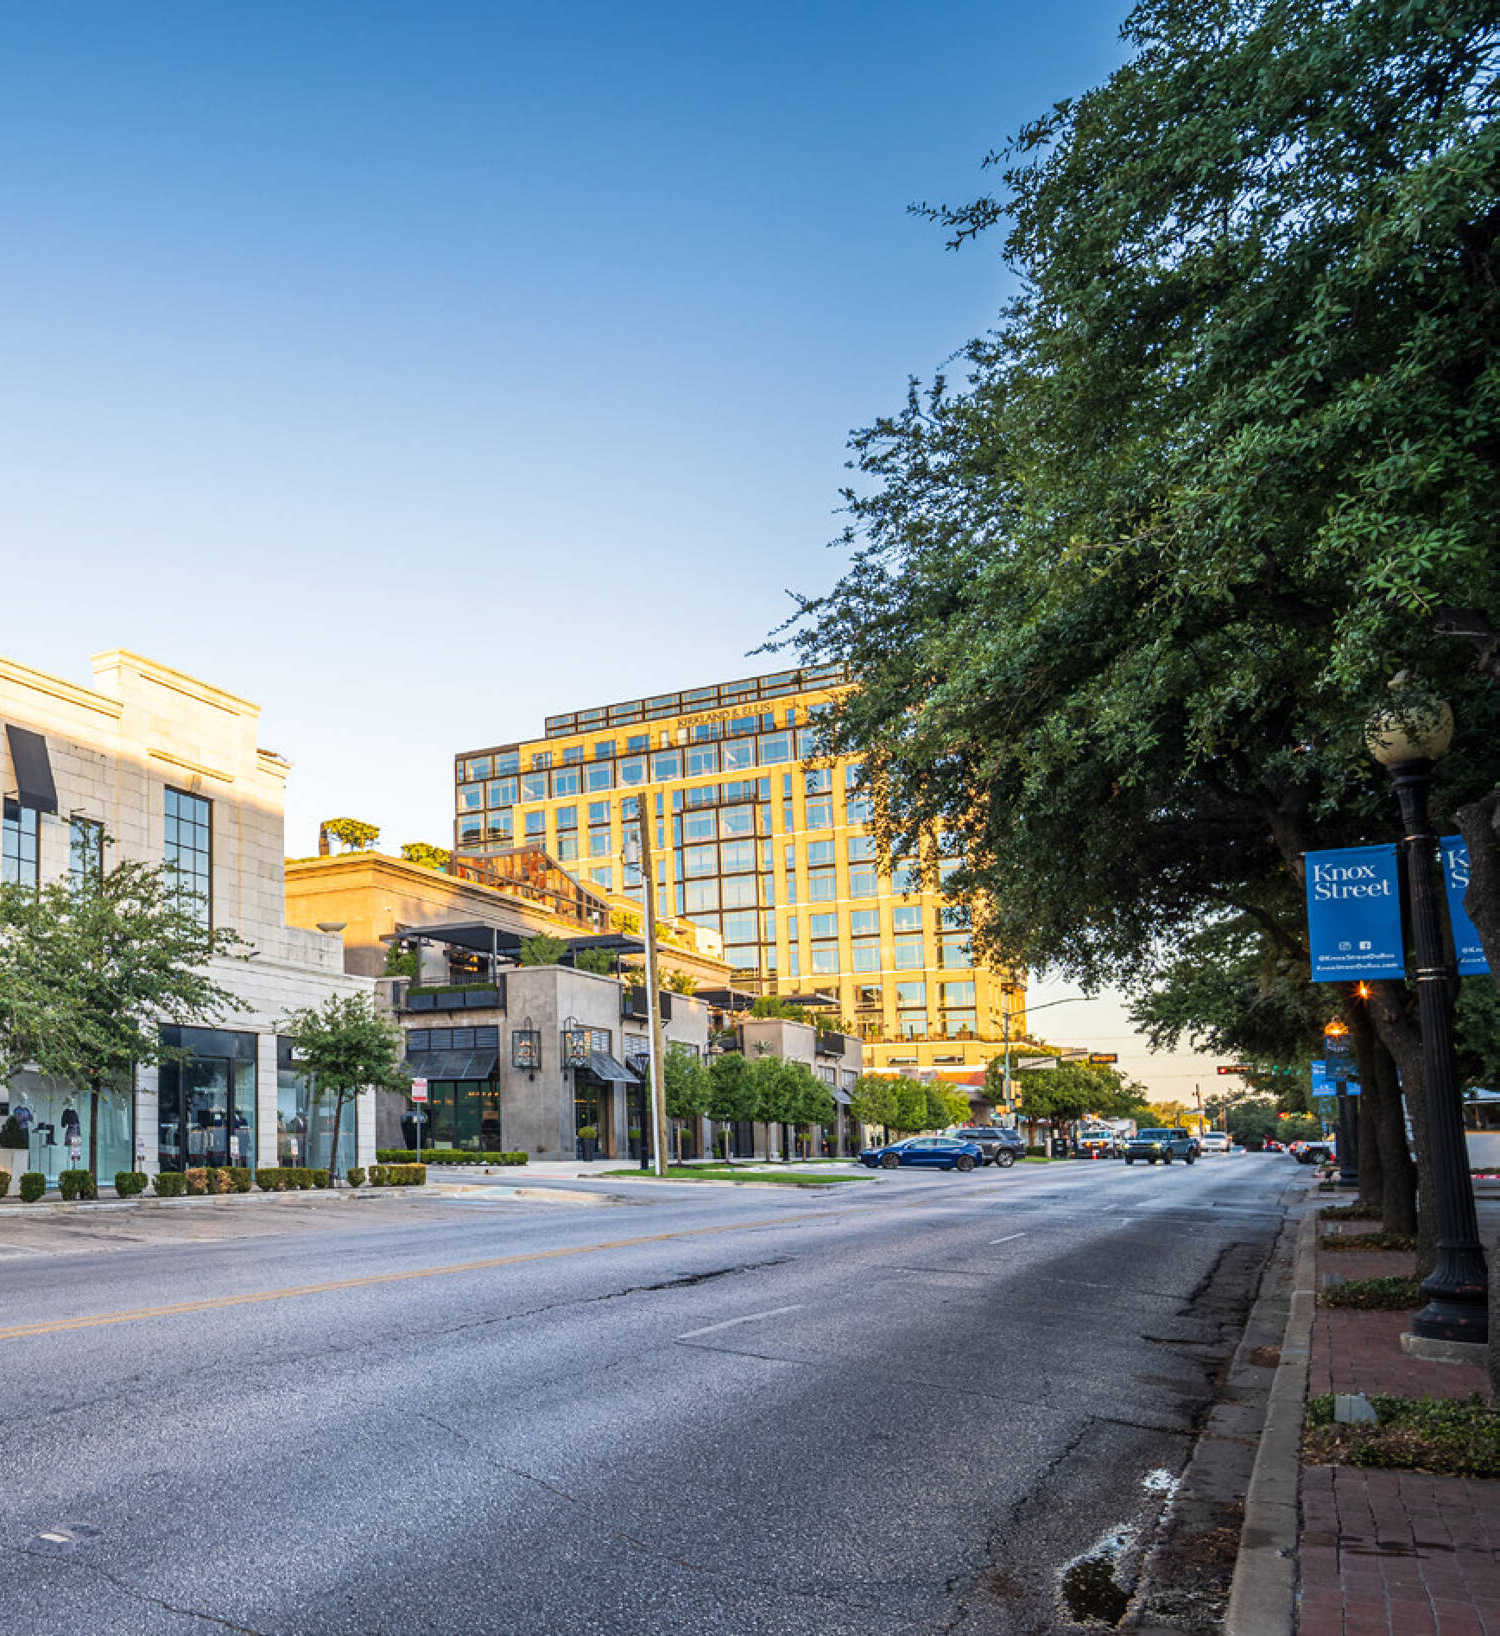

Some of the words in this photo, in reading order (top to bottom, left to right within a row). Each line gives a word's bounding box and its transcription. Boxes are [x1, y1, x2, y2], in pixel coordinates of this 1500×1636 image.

[677, 709, 731, 727] KIRKLAND
[742, 702, 771, 715] ELLIS
[1313, 863, 1376, 882] Knox
[1314, 879, 1393, 900] Street
